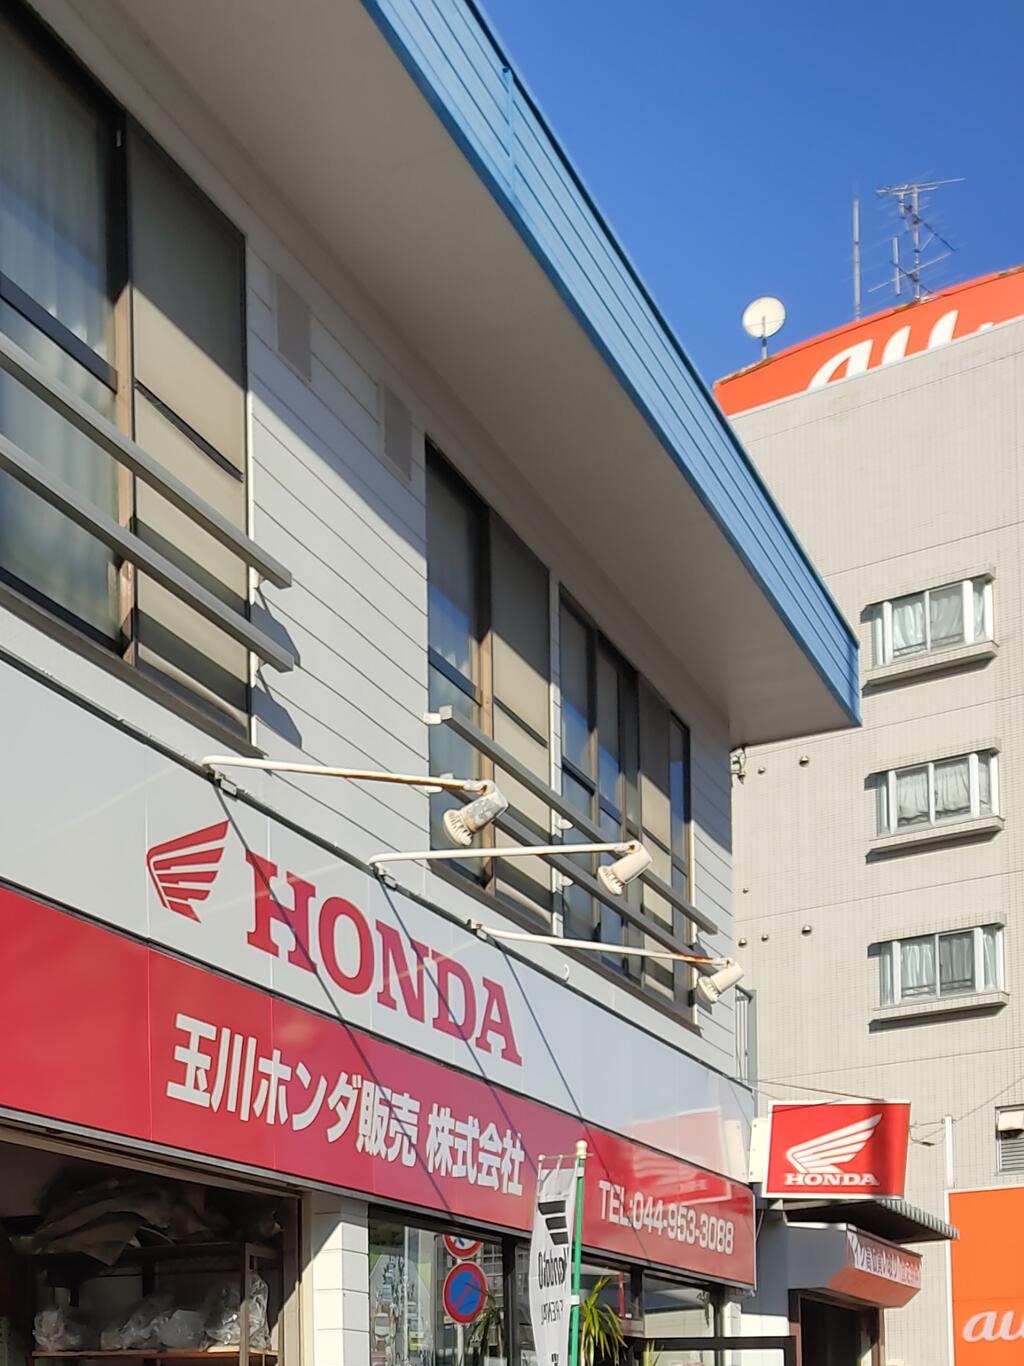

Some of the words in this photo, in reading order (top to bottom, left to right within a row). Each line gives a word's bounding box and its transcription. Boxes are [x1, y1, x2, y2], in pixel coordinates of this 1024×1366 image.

[245, 849, 522, 1066] HONDA
[166, 1012, 421, 1168] 玉川ホンダ販売
[426, 1101, 525, 1196] 株式会社
[784, 1172, 880, 1187] HONDA
